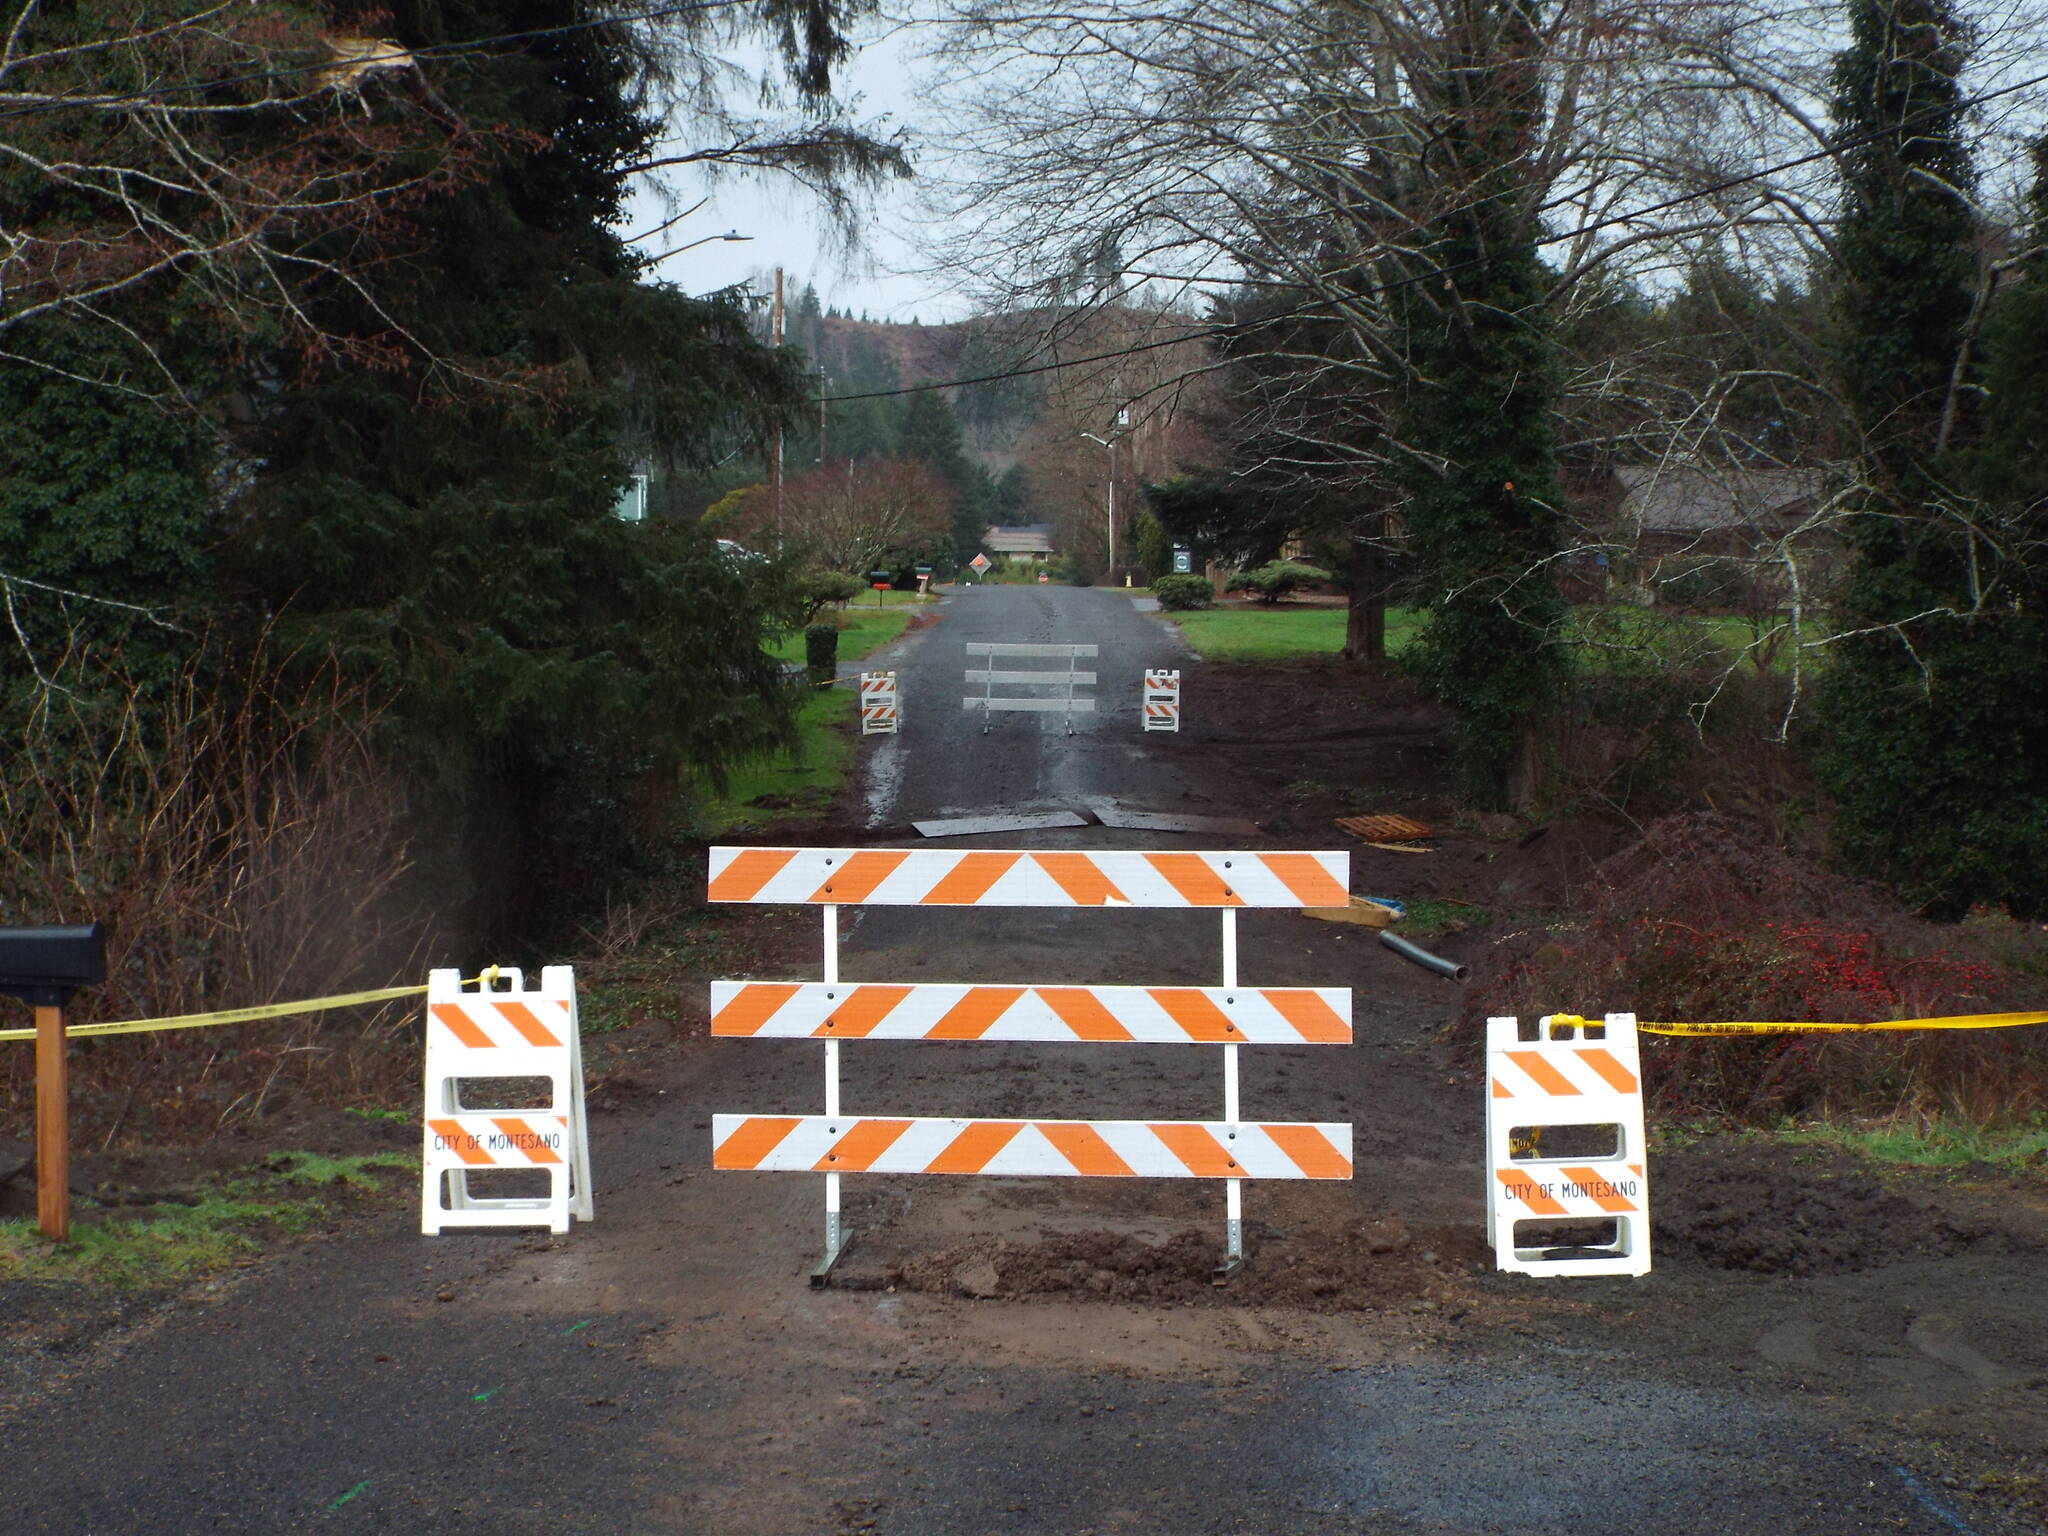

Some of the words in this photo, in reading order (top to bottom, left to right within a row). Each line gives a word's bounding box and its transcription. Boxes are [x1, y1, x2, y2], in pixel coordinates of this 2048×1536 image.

[434, 1135, 461, 1150] CITY
[467, 1134, 482, 1150] OF
[488, 1133, 560, 1150] MONTESANO
[1505, 1184, 1532, 1200] CITY
[1540, 1183, 1554, 1198] OF
[1562, 1181, 1636, 1198] MONTESANO
